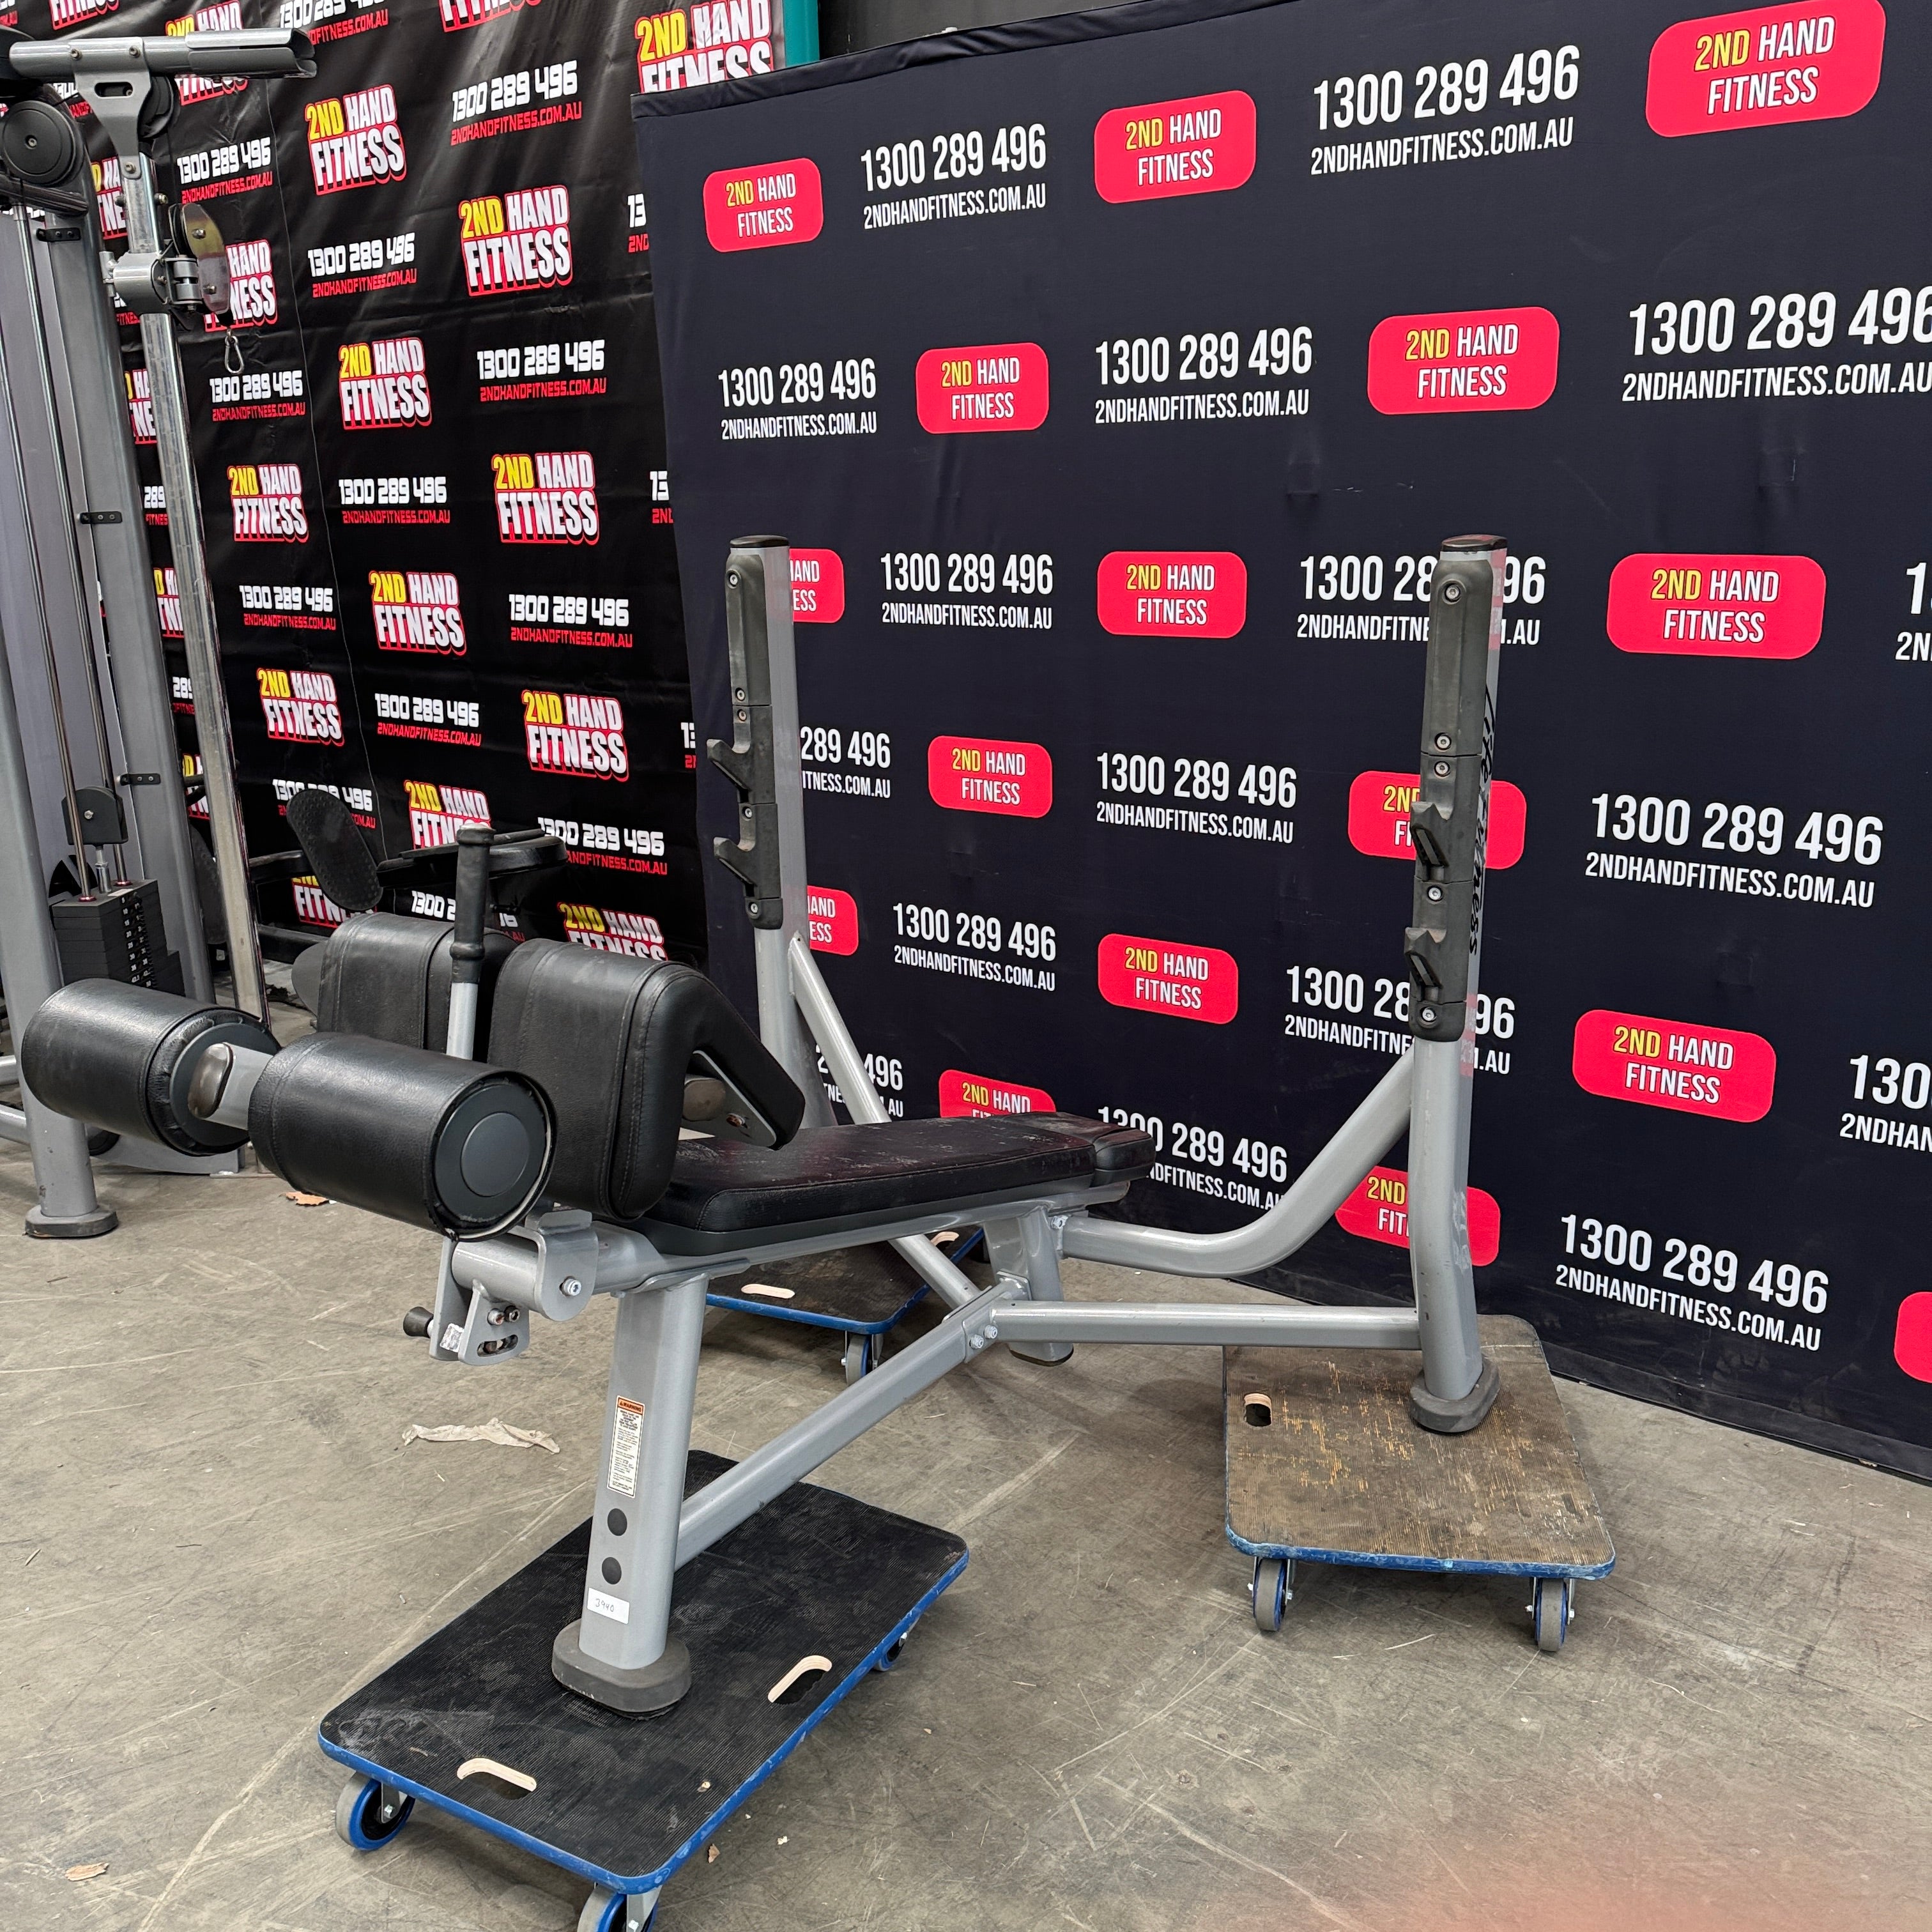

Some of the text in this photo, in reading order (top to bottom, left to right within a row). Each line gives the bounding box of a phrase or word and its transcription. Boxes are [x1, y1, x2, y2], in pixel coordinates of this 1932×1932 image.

[637, 0, 770, 62] 2ND HAND
[1695, 17, 1834, 70] 2ND HAND
[452, 60, 577, 122] 1300 289 496
[1314, 45, 1579, 130] 1300 289 496
[1708, 67, 1818, 114] FITNESS
[307, 88, 395, 140] 2ND HAND
[450, 101, 582, 146] 2NDHANDFITNESS.COM.AU
[1126, 109, 1221, 150] 2ND HAND
[177, 137, 270, 184] 1300 289 496
[311, 125, 404, 186] FITNESS
[861, 124, 1046, 191] 1300 289 496
[1311, 117, 1573, 174] 2NDHANDFITNESS.COM.AU
[1138, 149, 1213, 185] FITNESS
[181, 171, 273, 204] 2NDHANDFITNESS.COM.AU
[726, 174, 796, 206] 2ND HAND
[864, 183, 1045, 229] 2NDHANDFITNESS.COM.AU
[461, 188, 568, 238] 2ND HAND
[738, 207, 793, 237] FITNESS
[227, 242, 271, 277] HAND
[308, 233, 415, 277] 1300 289 496
[464, 227, 570, 286] FITNESS
[312, 269, 417, 298] 2NDHANDFITNESS.COM.AU
[1630, 286, 1932, 355] 1300 289 496
[340, 340, 424, 378] 2ND HAND
[477, 340, 604, 379] 1300 289 496
[1096, 326, 1312, 385] 1300 289 496
[1406, 325, 1518, 359] 2ND HAND
[210, 371, 303, 402] 1300 289 496
[480, 378, 606, 401] 2NDHANDFITNESS.COM.AU
[718, 358, 876, 407] 1300 289 496
[942, 358, 1019, 387] 2ND HAND
[1418, 365, 1506, 397] FITNESS
[1622, 362, 1932, 401] 2NDHANDFITNESS.COM.AU
[213, 404, 305, 421] 2NDHANDFITNESS.COM.AU
[341, 374, 429, 421] FITNESS
[953, 392, 1014, 419] FITNESS
[1096, 389, 1308, 424] 2NDHANDFITNESS.COM.AU
[721, 411, 877, 440] 2NDHANDFITNESS.COM.AU
[229, 466, 301, 495] 2ND HAND
[339, 477, 447, 504] 1300 289 496
[493, 454, 594, 489] 2ND HAND
[233, 497, 307, 535] FITNESS
[342, 510, 450, 524] 2NDHANDFITNESS.COM.AU
[498, 491, 597, 535] FITNESS
[371, 573, 457, 605] 2ND HAND
[881, 553, 1052, 594] 1300 289 496
[1128, 565, 1215, 590] 2ND HAND
[1301, 556, 1383, 601] 1300
[1652, 570, 1779, 601] 2ND HAND
[240, 585, 333, 611] 1300 289 496
[509, 594, 629, 626] 1300 289 496
[882, 602, 1052, 629] 2NDHANDFITNESS.COM.AU
[1138, 599, 1206, 624] FITNESS
[243, 613, 336, 630] 2NDHANDFITNESS.COM.AU
[374, 605, 464, 647] FITNESS
[511, 627, 632, 648] 2NDHANDFITNESS.COM.AU
[1664, 610, 1765, 642] FITNESS
[258, 670, 335, 702] 2ND HAND
[263, 698, 341, 739] FITNESS
[375, 693, 479, 727] 1300 289 496
[523, 692, 622, 730] 2ND HAND
[378, 723, 481, 746] 2NDHANDFITNESS.COM.AU
[527, 725, 626, 773] FITNESS
[799, 726, 890, 768] 289 496
[953, 748, 1025, 776] 2ND HAND
[1097, 753, 1296, 808] 1300 289 496
[343, 787, 372, 811] 496
[406, 782, 489, 820] 2ND HAND
[962, 778, 1020, 804] FITNESS
[583, 824, 620, 850] 289
[624, 829, 664, 855] 496
[1097, 801, 1293, 843] 2NDHANDFITNESS.COM.AU
[1592, 793, 1883, 865] 1300 289 496
[1586, 852, 1874, 907] 2NDHANDFITNESS.COM.AU
[412, 891, 445, 918] 1300
[560, 903, 663, 944] 2ND HAND
[893, 903, 1055, 961] 1300 289 496
[894, 945, 1055, 991] 2NDHANDFITNESS.COM.AU
[1126, 947, 1208, 980] 2ND HAND
[1137, 977, 1201, 1009] FITNESS
[1287, 966, 1363, 1013] 1300
[1614, 1027, 1733, 1069] 2ND HAND
[864, 1054, 903, 1091] 496
[1627, 1062, 1720, 1103] FITNESS
[963, 1083, 988, 1105] 2ND
[993, 1090, 1030, 1113] HAND
[1172, 1123, 1287, 1182] 289 496
[1368, 1177, 1404, 1204] 2ND
[1561, 1215, 1828, 1313] 1300 289 496
[1556, 1265, 1820, 1351] 2NDHANDFITNESS.COM.AU
[595, 1598, 614, 1613] 3940
